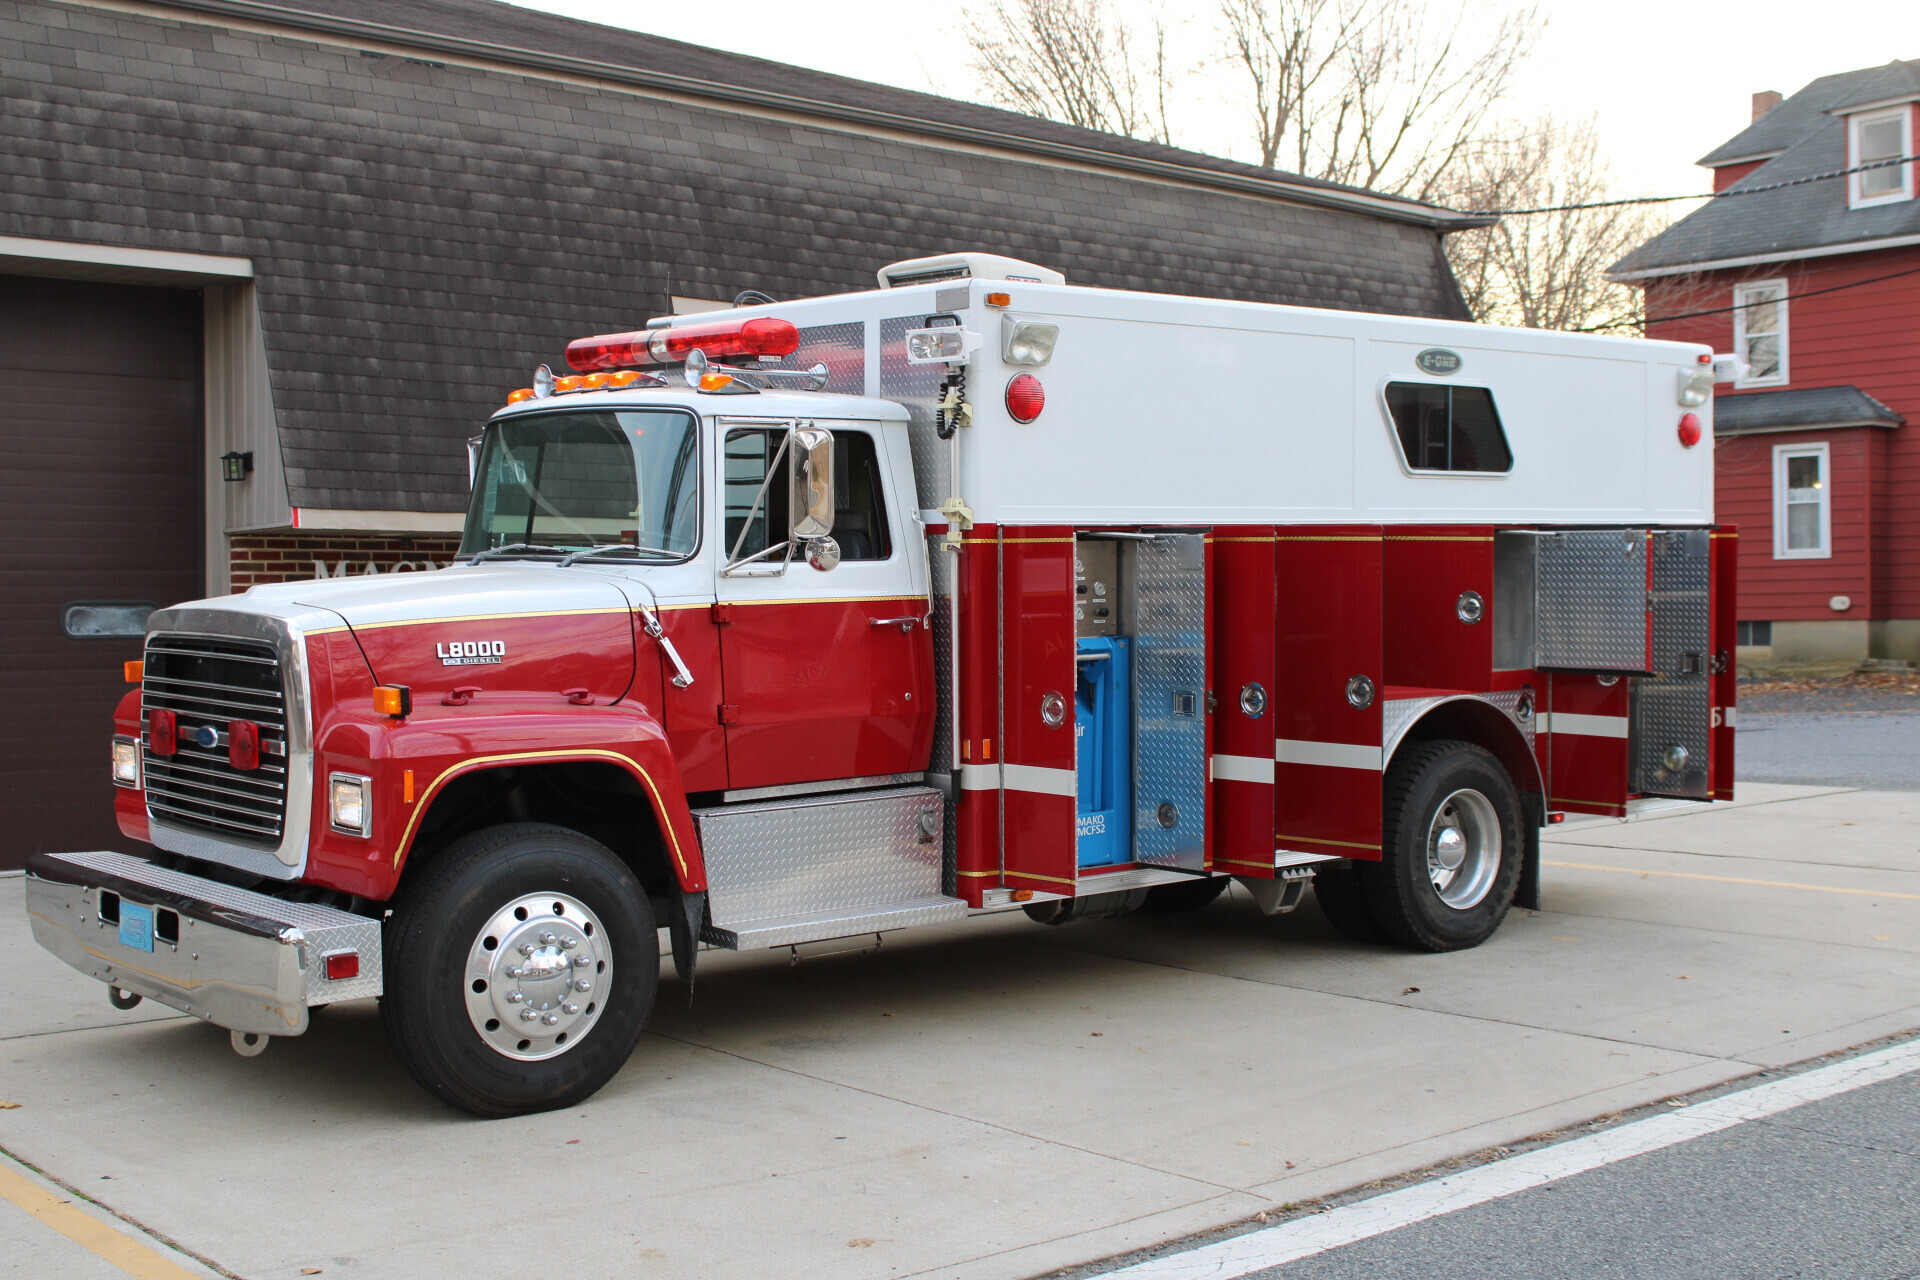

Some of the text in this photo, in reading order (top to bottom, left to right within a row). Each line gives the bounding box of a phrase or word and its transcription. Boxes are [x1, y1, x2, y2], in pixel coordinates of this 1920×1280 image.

[436, 640, 506, 658] L8000
[1077, 814, 1105, 827] MAKO
[1077, 823, 1106, 837] MCFS2
